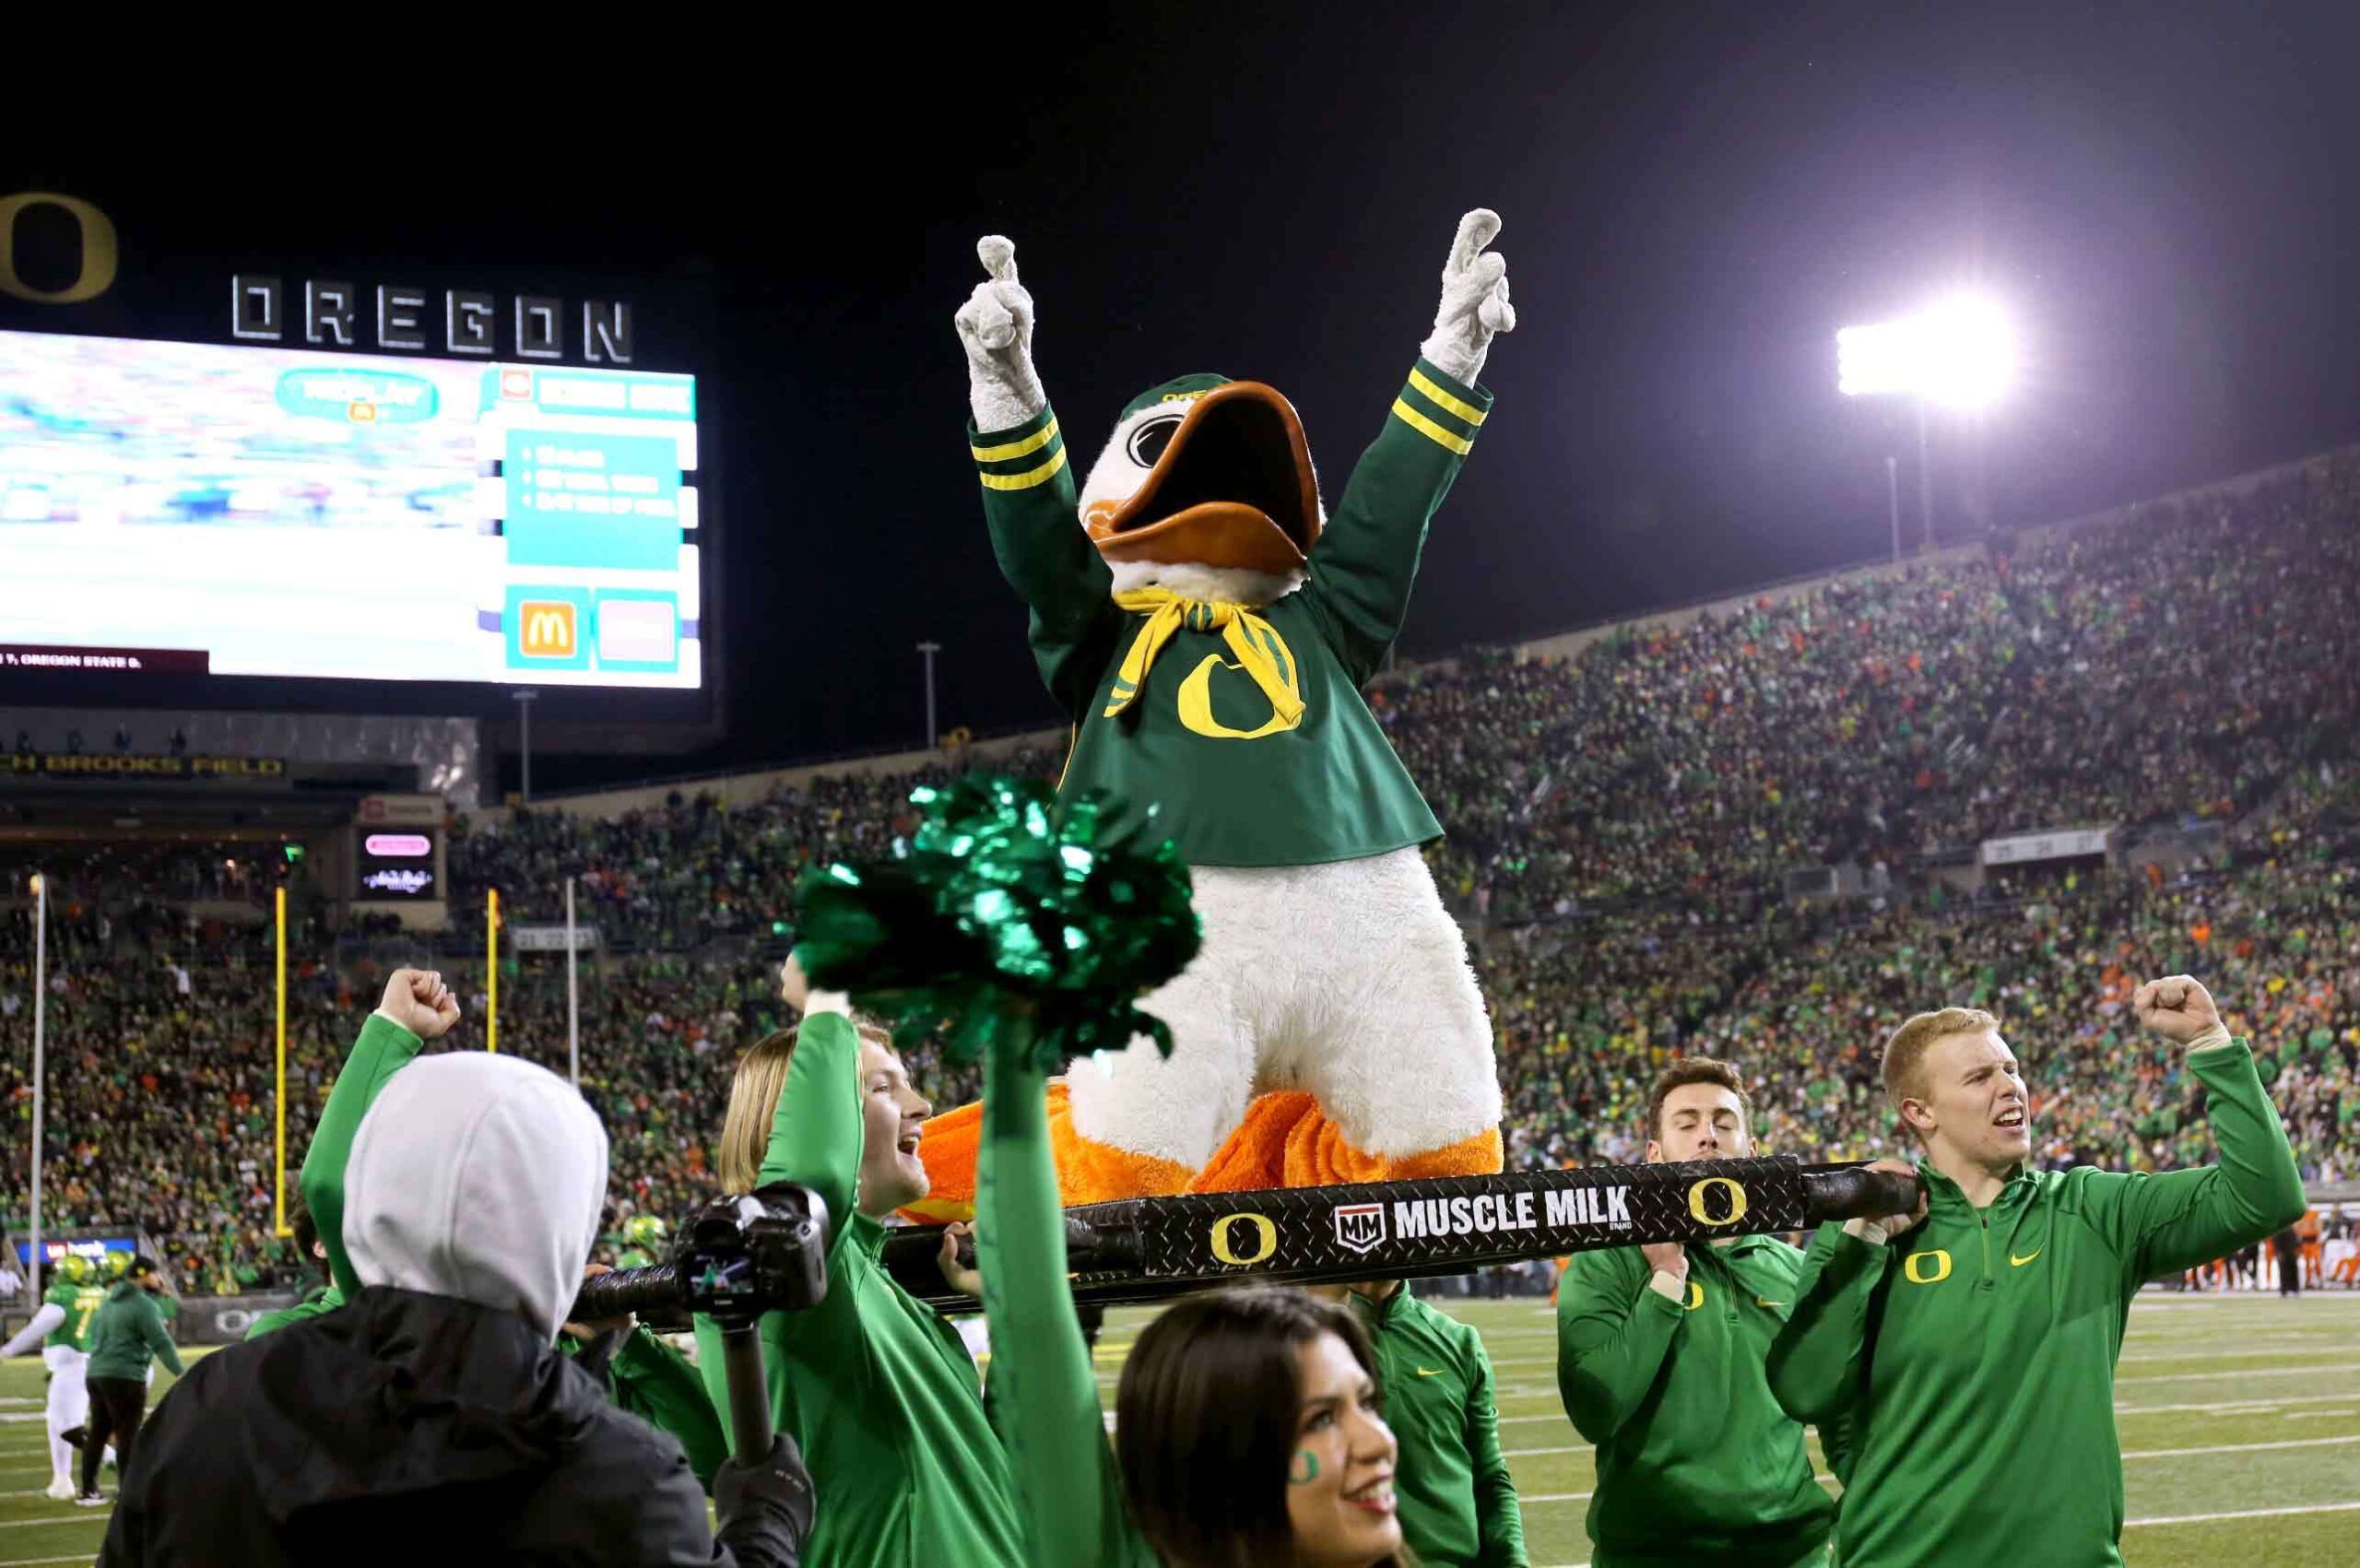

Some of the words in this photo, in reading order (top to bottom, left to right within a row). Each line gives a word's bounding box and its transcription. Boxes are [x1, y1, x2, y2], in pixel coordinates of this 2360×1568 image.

[0, 192, 118, 303] O
[232, 275, 633, 363] OREGON
[20, 654, 82, 667] OREGON
[45, 756, 183, 772] BROOKS
[192, 757, 281, 774] FIELD
[1394, 1193, 1538, 1239] MUSCLE
[1545, 1185, 1631, 1235] MILK
[1688, 1176, 1748, 1226] O
[1210, 1212, 1277, 1265] O
[1905, 1249, 1953, 1284] O
